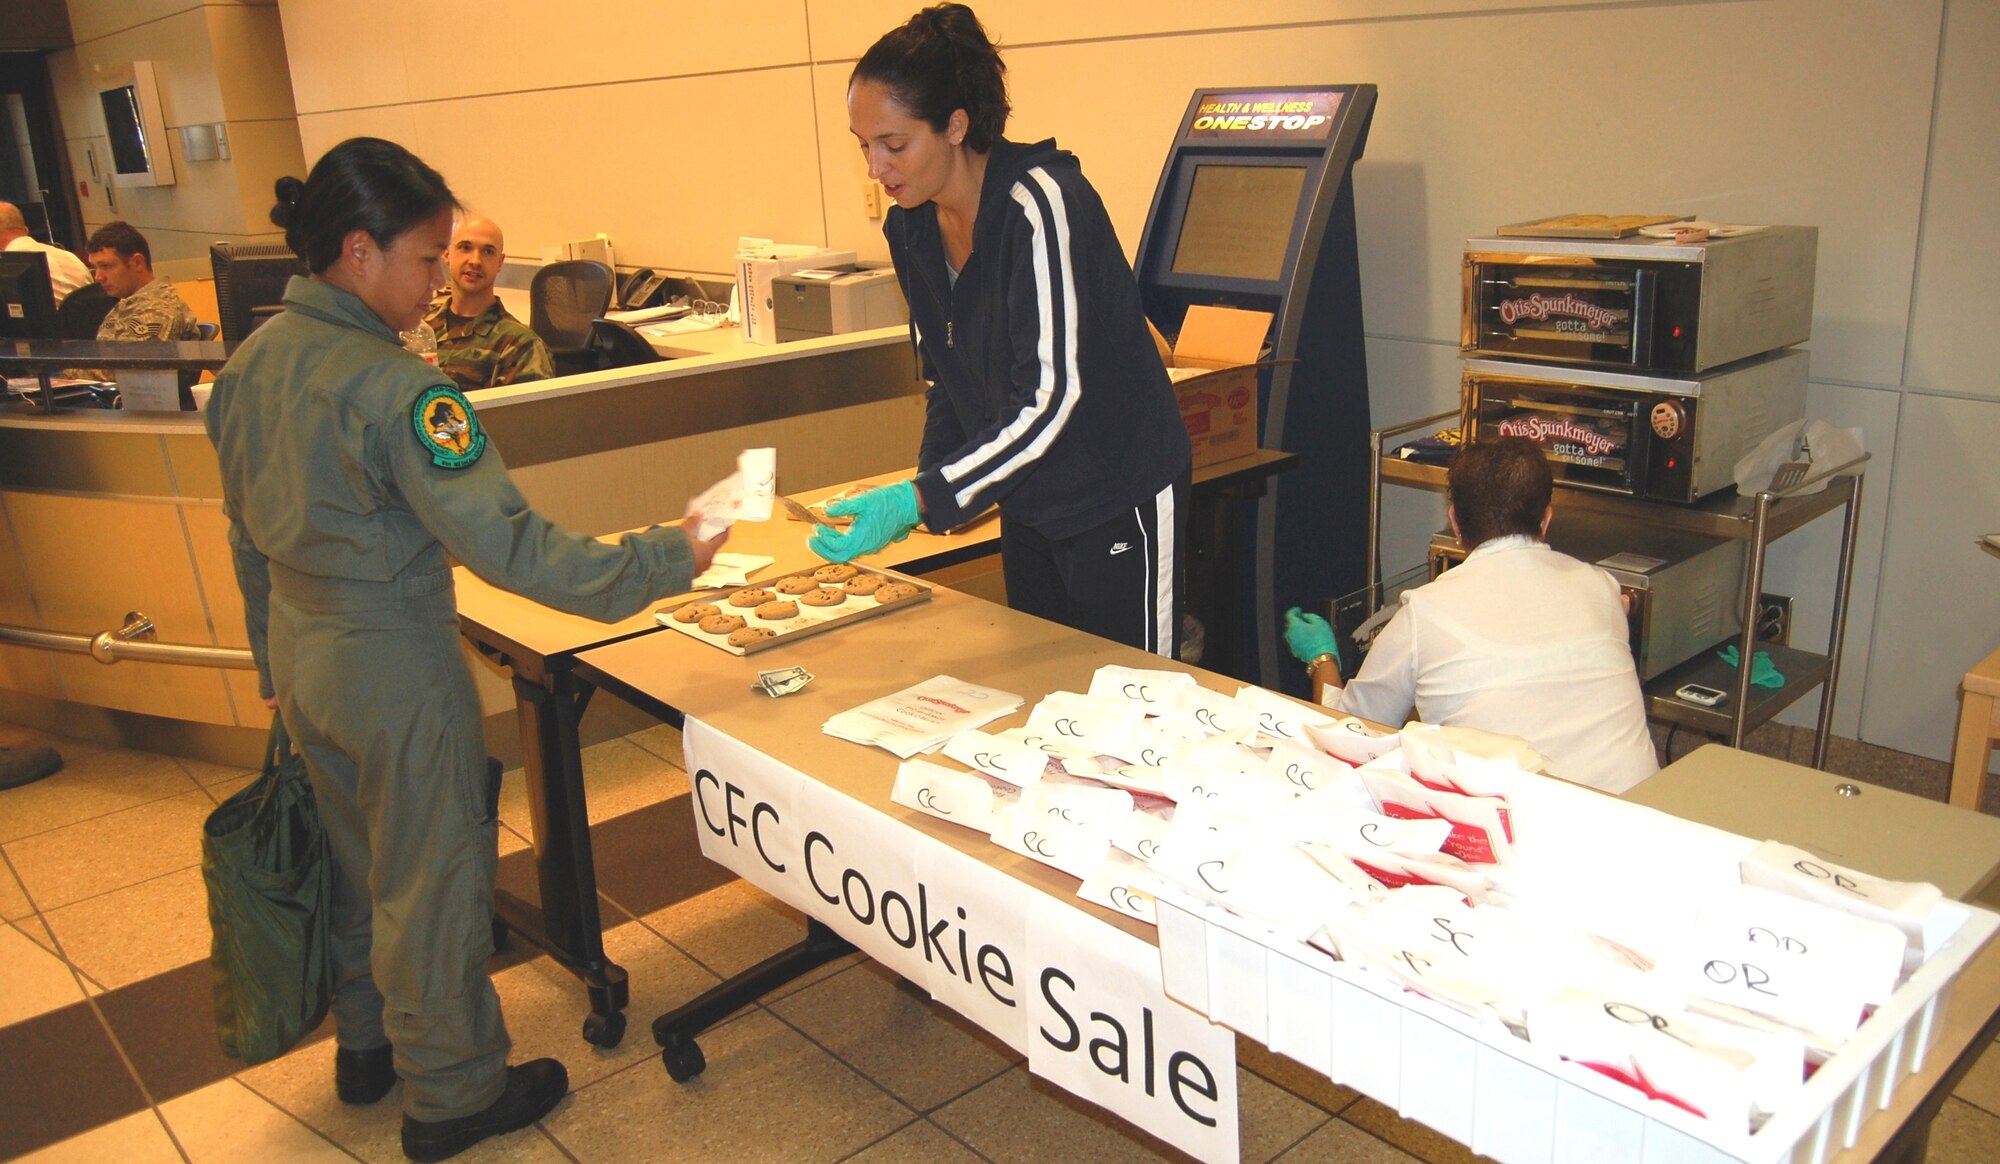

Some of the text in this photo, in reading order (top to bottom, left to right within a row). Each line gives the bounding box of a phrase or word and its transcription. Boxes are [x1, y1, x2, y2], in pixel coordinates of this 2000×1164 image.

[1200, 101, 1313, 113] HEALTH & WELLNESS
[1193, 115, 1325, 130] ONESTOP
[1555, 320, 1587, 333] gotta
[1553, 443, 1585, 456] gotta
[1113, 542, 1129, 550] NIKE
[1122, 683, 1157, 703] CC
[1054, 717, 1086, 737] CC
[1195, 708, 1226, 732] CC
[1258, 712, 1295, 738] CC
[974, 752, 1008, 771] CC
[1285, 763, 1316, 790] CC
[917, 787, 952, 814] CC
[1023, 831, 1056, 858] CC
[1110, 886, 1143, 912] CC
[695, 768, 1219, 1128] CFC Cookie Sale
[1703, 959, 1779, 997] OR
